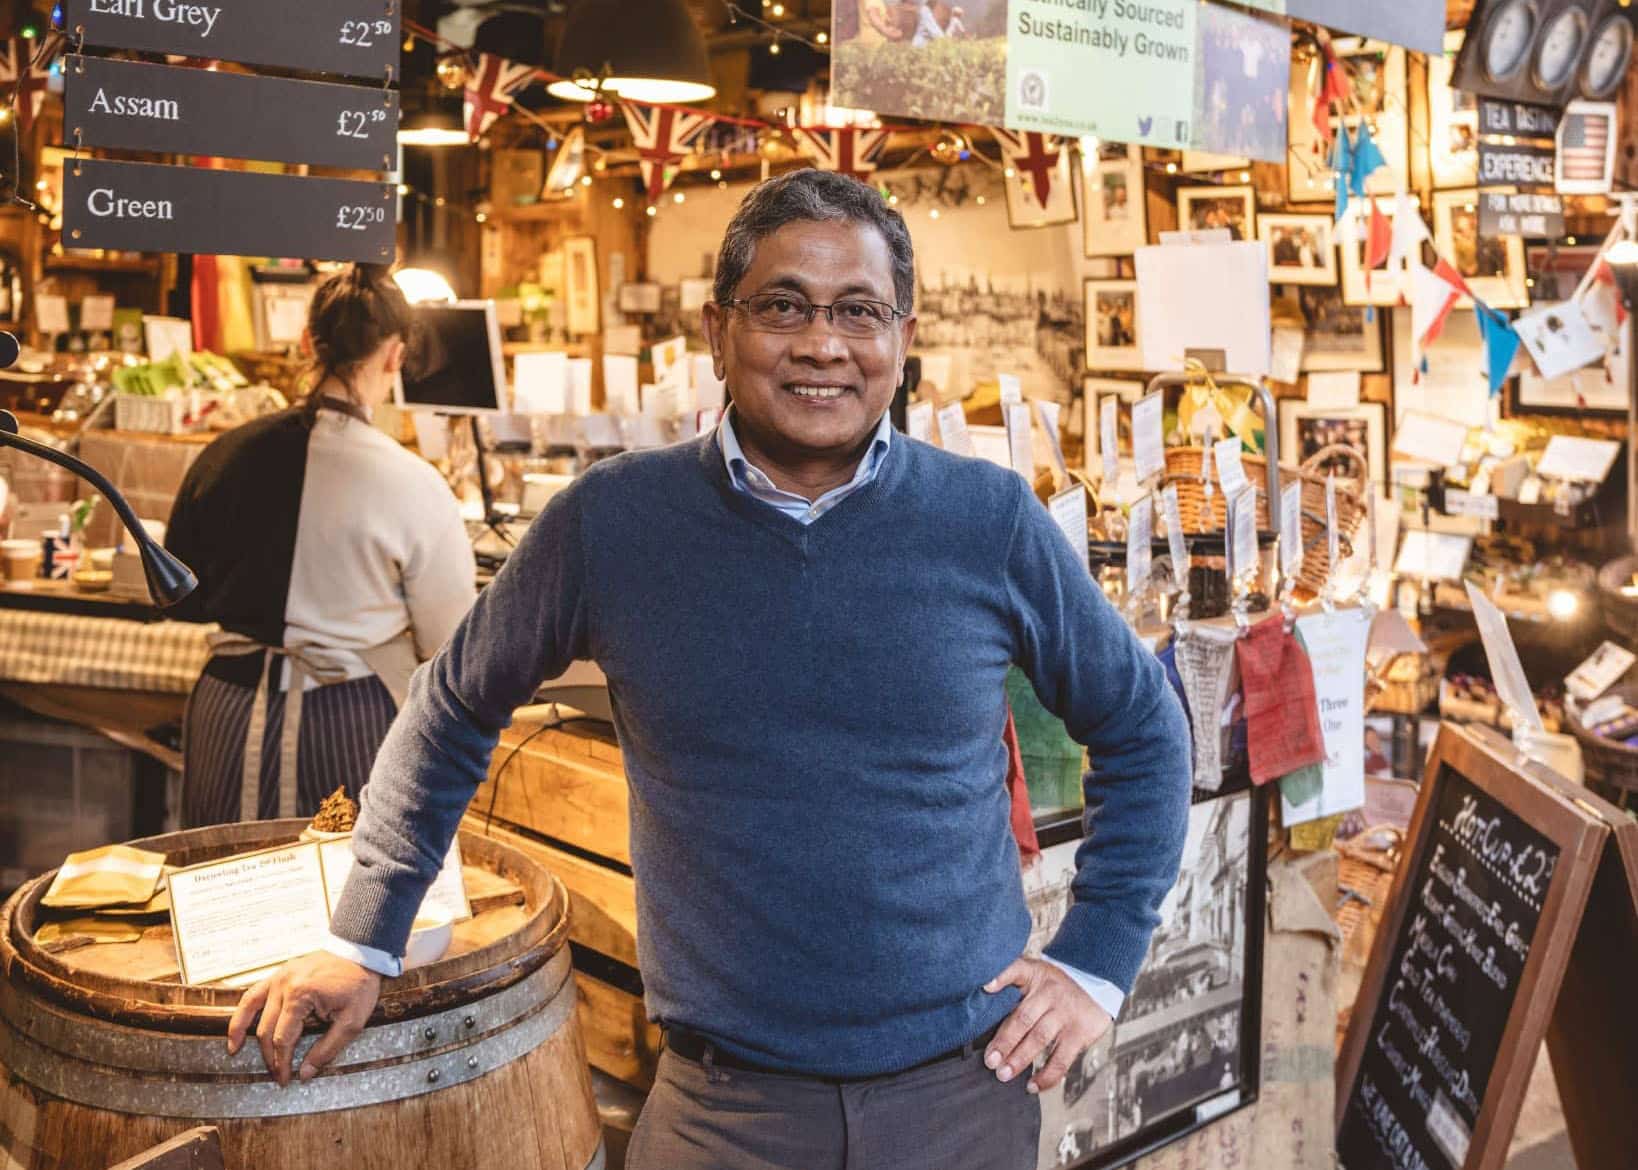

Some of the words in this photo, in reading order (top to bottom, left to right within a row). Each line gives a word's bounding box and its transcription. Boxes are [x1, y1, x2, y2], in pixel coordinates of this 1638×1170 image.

[152, 0, 222, 38] Grey
[1027, 0, 1106, 19] cally
[1113, 0, 1185, 30] Sourced
[1018, 11, 1129, 57] Sustainably
[1134, 32, 1189, 63] Grown
[88, 88, 179, 119] Assam
[87, 188, 173, 219] Green
